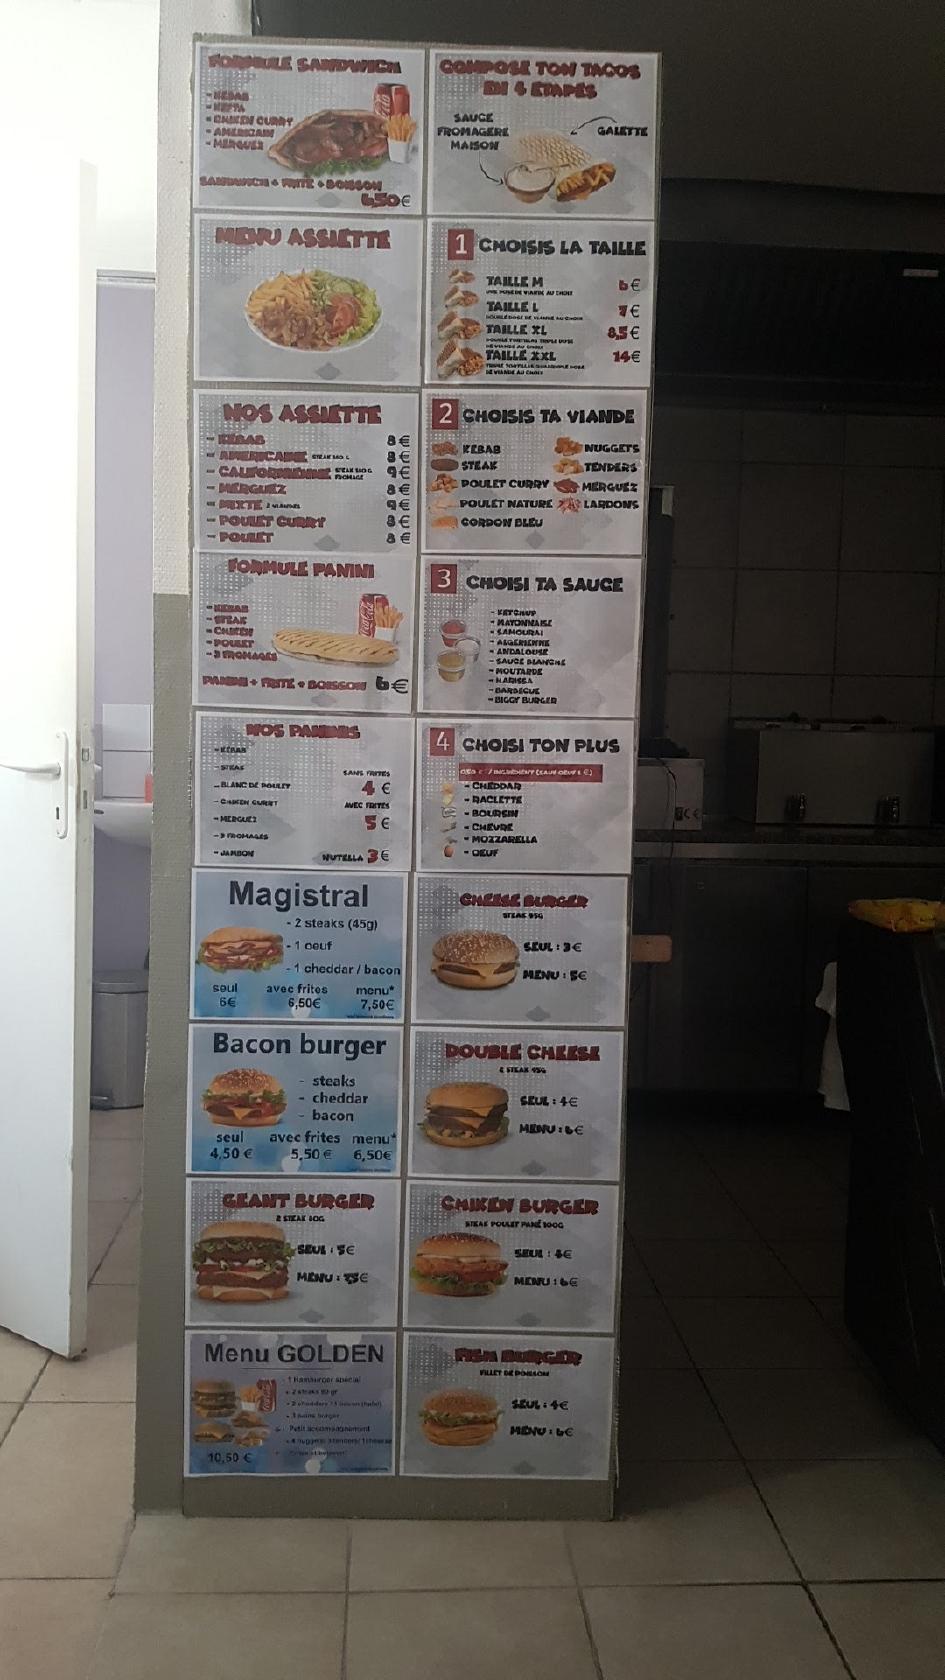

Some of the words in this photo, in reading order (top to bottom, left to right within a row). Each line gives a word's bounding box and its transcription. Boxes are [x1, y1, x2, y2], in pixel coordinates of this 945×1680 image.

[208, 53, 292, 71] FORMULE
[297, 57, 401, 73] SANDWICH
[440, 59, 530, 75] COMPOSE
[535, 61, 577, 77] TON
[581, 63, 641, 79] TACOS
[484, 80, 508, 96] EN
[514, 82, 527, 96] 4
[531, 82, 597, 99] ETAPES
[257, 116, 294, 126] CURRY
[454, 113, 493, 123] SAUCE
[598, 126, 648, 137] GALETTE
[451, 141, 499, 150] MAISON
[200, 176, 269, 187] SANDWICH
[282, 178, 314, 189] FRITE
[326, 180, 382, 191] BOISSON
[216, 227, 281, 246] MENU
[288, 228, 391, 249] ASSIETTE
[456, 234, 467, 255] 1
[479, 238, 555, 255] CHOISIS
[560, 240, 583, 255] LA
[589, 240, 647, 256] TAILLE
[487, 276, 529, 287] TAILLE
[532, 277, 543, 287] M
[487, 301, 528, 312] TAILLE
[533, 303, 539, 312] L
[486, 325, 527, 335] TAILLE
[532, 326, 547, 336] XL
[486, 350, 527, 361] TAILLE
[531, 351, 556, 361] XXL
[223, 403, 273, 423] NOS
[279, 404, 382, 424] ASSIETTE
[439, 403, 452, 424] 2
[462, 409, 535, 424] CHOISIS
[540, 409, 561, 423] TA
[567, 409, 634, 424] VIANDE
[218, 434, 265, 445] KEBAB
[462, 444, 501, 454] KEBAB
[584, 444, 640, 453] NUGGETS
[461, 461, 498, 471] STEAK
[584, 462, 638, 473] TENDERS
[219, 483, 287, 494] MERGUEZ
[461, 479, 506, 488] POULET
[509, 480, 549, 489] CURRY
[582, 482, 638, 493] MERGUEZ
[460, 499, 504, 508] POULET
[508, 500, 553, 509] NATURE
[584, 500, 639, 510] LARDONS
[219, 515, 274, 527] POULET
[277, 516, 326, 529] CURRY
[461, 517, 512, 527] CORDON
[515, 518, 543, 527] BLEU
[220, 532, 274, 543] POULET
[228, 558, 308, 576] FORMULE
[313, 562, 374, 578] PANINI
[438, 569, 451, 588] 3
[466, 575, 530, 591] CHOISI
[535, 577, 557, 591] TA
[563, 577, 624, 592] SAUCE
[214, 639, 254, 648] POULET
[261, 677, 295, 689] FRITE
[308, 680, 367, 691] BOISSON
[246, 723, 284, 737] NOS
[289, 725, 360, 739] PANINIS
[436, 731, 450, 751] 4
[463, 738, 524, 752] CHOISI
[530, 738, 570, 752] TON
[575, 739, 620, 753] PLUS
[362, 780, 375, 796] 4
[473, 782, 521, 790] CHEDDAR
[472, 796, 522, 804] RACLETTE
[365, 815, 376, 831] 5
[472, 823, 513, 832] CHEVRE
[472, 849, 498, 857] OEUF
[229, 881, 368, 912] Magistral
[460, 893, 520, 907] CHEESE
[524, 894, 588, 909] BURGER
[295, 918, 301, 928] 2
[305, 919, 344, 929] steaks
[347, 919, 378, 931] (45g)
[305, 941, 332, 951] oeuf
[524, 942, 553, 952] SEUL
[305, 964, 354, 975] cheddar
[365, 965, 400, 975] bacon
[523, 970, 559, 980] MENU
[213, 984, 237, 993] seul
[266, 985, 294, 994] avec
[298, 984, 328, 994] frites
[220, 997, 236, 1007] 6€
[288, 997, 321, 1010] 6,50€
[361, 1000, 394, 1011] 7,50€
[213, 1033, 290, 1054] Bacon
[301, 1033, 386, 1061] burger
[445, 1043, 522, 1061] DOUBLE
[528, 1044, 600, 1061] CHEESE
[313, 1075, 355, 1087] steaks
[313, 1092, 368, 1104] cheddar
[520, 1096, 549, 1106] SEUL
[313, 1110, 354, 1122] bacon
[519, 1124, 556, 1134] MENU
[217, 1131, 243, 1143] seul
[270, 1134, 300, 1144] avec
[305, 1131, 340, 1144] frites
[354, 1150, 392, 1162] 6,50€
[223, 1193, 290, 1209] GEANT
[295, 1193, 375, 1210] BURGER
[519, 1198, 599, 1216] BURGER
[298, 1244, 326, 1255] SEUL
[515, 1249, 543, 1258] SEUL
[297, 1272, 333, 1283] MENU
[514, 1277, 550, 1286] MENU
[205, 1343, 269, 1362] Menu
[278, 1344, 383, 1363] GOLDEN
[501, 1349, 583, 1366] BURGER
[512, 1399, 541, 1410] SEUL
[208, 1452, 239, 1464] 10,50
